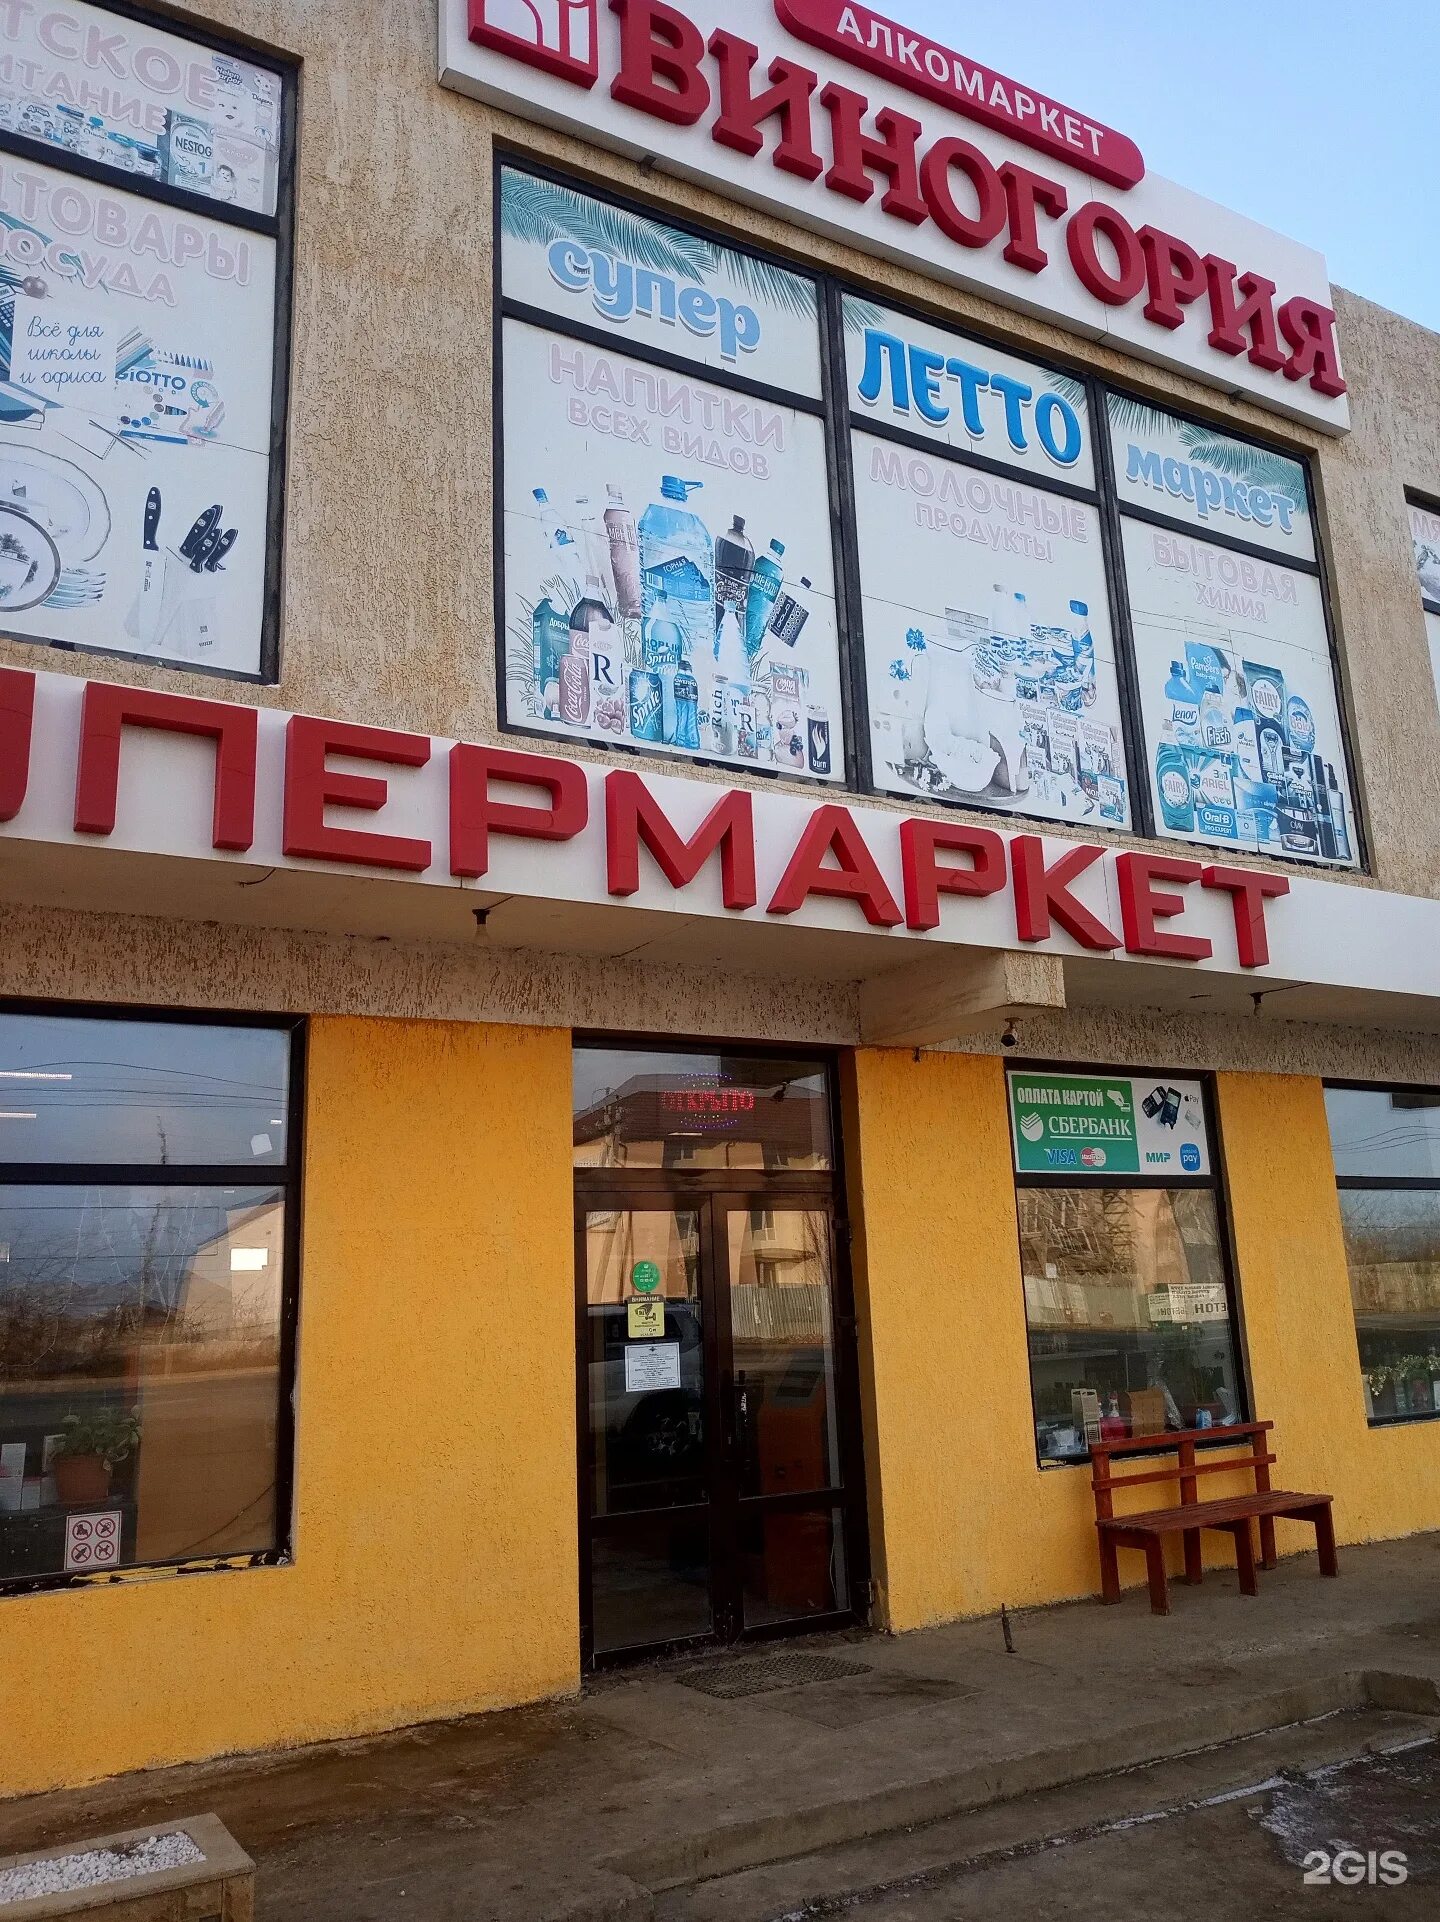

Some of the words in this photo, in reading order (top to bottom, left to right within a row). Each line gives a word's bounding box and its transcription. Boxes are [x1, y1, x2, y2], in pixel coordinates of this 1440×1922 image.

[215, 65, 240, 81] Helen
[836, 7, 1104, 158] АЛКОМАРКЕТ
[175, 135, 212, 157] NESTOG
[610, 0, 1346, 398] ВИНОГОРИЯ
[547, 238, 762, 360] супер
[27, 315, 62, 338] Всё
[67, 323, 104, 346] для
[27, 347, 102, 361] школы
[19, 371, 36, 384] и
[40, 368, 107, 392] офиса
[550, 343, 785, 451] НАПИТКИ
[857, 327, 1082, 468] ЛЕТТО
[567, 397, 652, 445] ВСЕХ
[661, 425, 771, 480] ВИДОВ
[869, 447, 1088, 543] МОЛОЧНЫЕ
[1125, 443, 1295, 534] маркет
[914, 503, 1054, 564] ПРОДУКТЫ
[1151, 533, 1300, 606] БЫТОВАЯ
[1194, 581, 1268, 623] ХИМИЯ
[591, 652, 615, 685] R
[646, 651, 675, 667] Sprite
[1190, 656, 1220, 675] Pampers
[632, 690, 661, 728] Sprite
[712, 690, 724, 729] Rich
[1254, 689, 1280, 711] FAIRY
[739, 712, 755, 732] R
[1206, 725, 1232, 747] Flash
[812, 758, 827, 769] burn
[1164, 778, 1188, 795] FAIRY
[1201, 777, 1230, 791] ARIEL
[1203, 811, 1230, 824] Oral-B
[1017, 1087, 1062, 1105] ОПЛАТА
[1063, 1088, 1104, 1107] КАРТОЙ
[1048, 1115, 1133, 1136] СБЕРБАНК
[1044, 1147, 1077, 1165] VISA
[1146, 1151, 1171, 1163] МИР
[1182, 1153, 1199, 1164] pay
